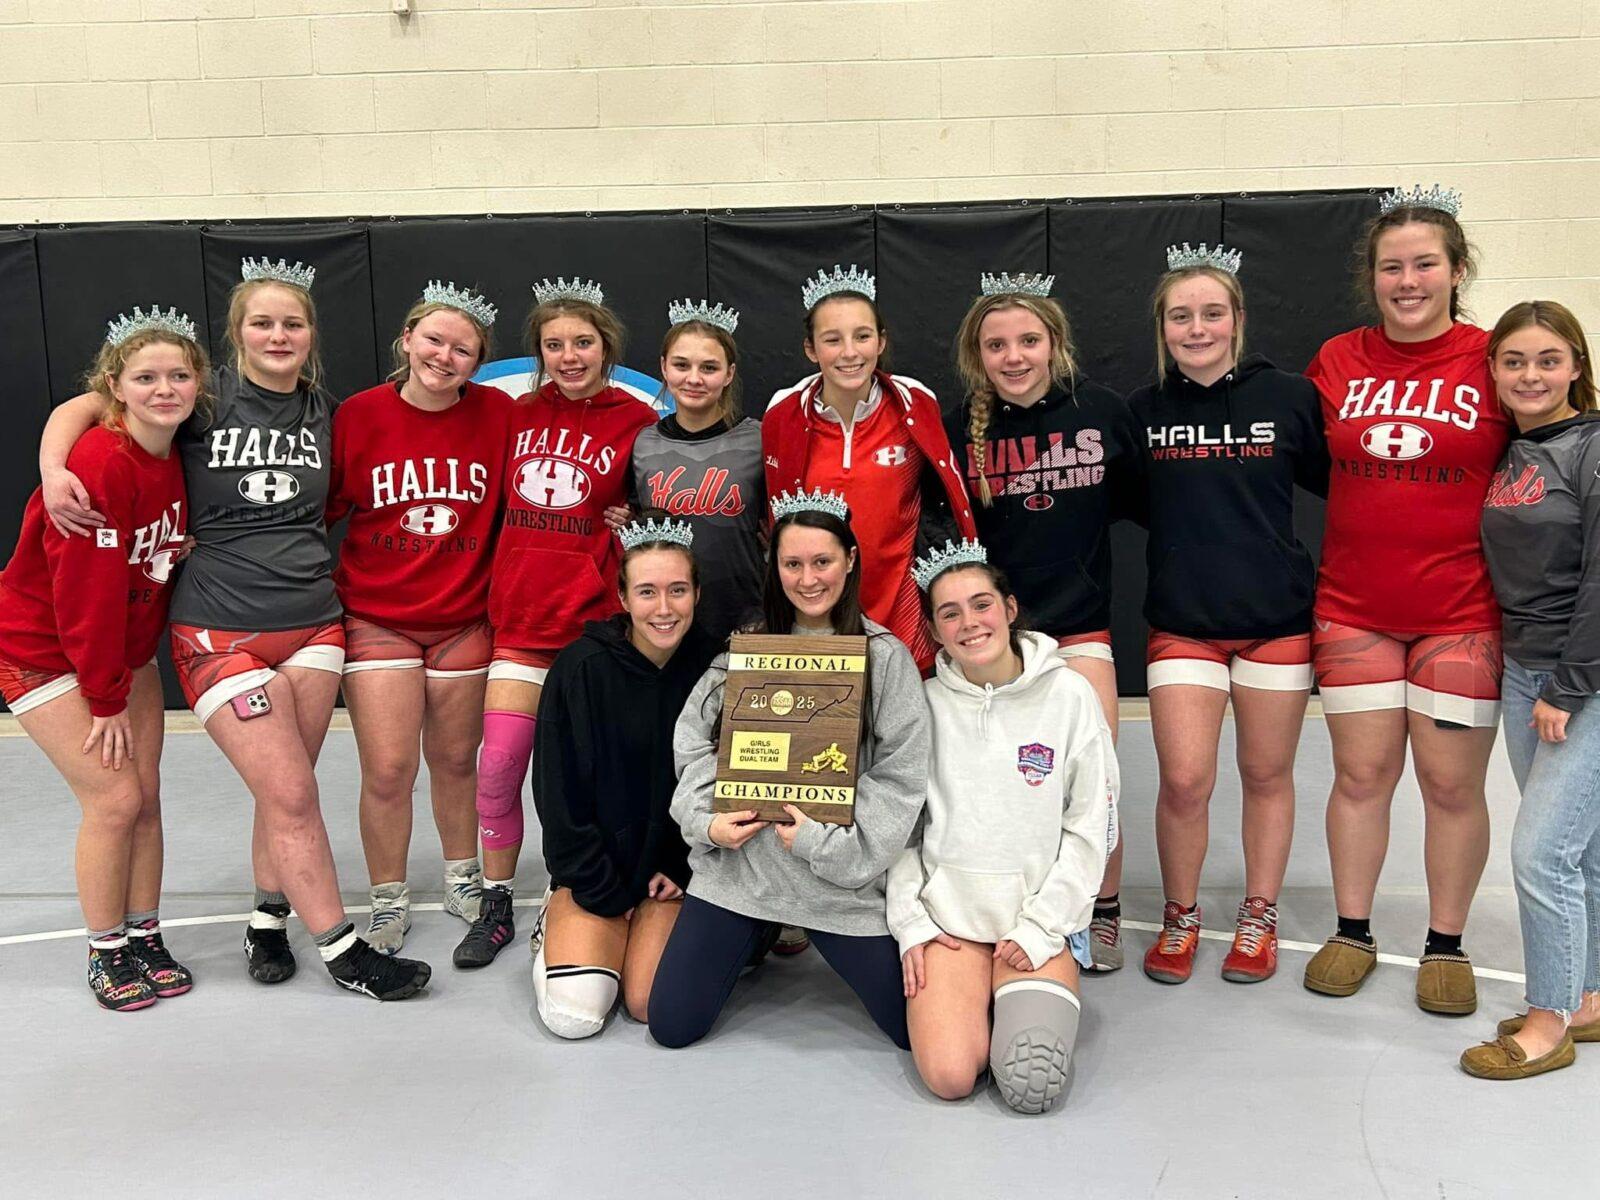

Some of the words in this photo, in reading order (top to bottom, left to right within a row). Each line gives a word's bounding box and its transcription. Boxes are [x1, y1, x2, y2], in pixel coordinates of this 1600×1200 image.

[1338, 377, 1481, 431] HALLS
[1146, 421, 1276, 447] HALLS
[1364, 424, 1425, 458] H
[207, 427, 322, 470] HALLS
[513, 427, 617, 476] HALLS
[876, 445, 907, 466] H
[966, 428, 1105, 477] HALLS
[1151, 445, 1273, 460] WRESTLING
[371, 457, 488, 509] HALLS
[1338, 457, 1466, 484] WRESTLING
[245, 472, 293, 503] H
[648, 465, 746, 517] Halls
[404, 507, 454, 534] H
[506, 508, 593, 537] WRESTLING
[371, 530, 478, 552] WRESTLING
[745, 657, 851, 671] REGIONAL
[750, 695, 767, 708] 20
[796, 696, 815, 710] 25
[721, 784, 847, 801] CHAMPIONS
